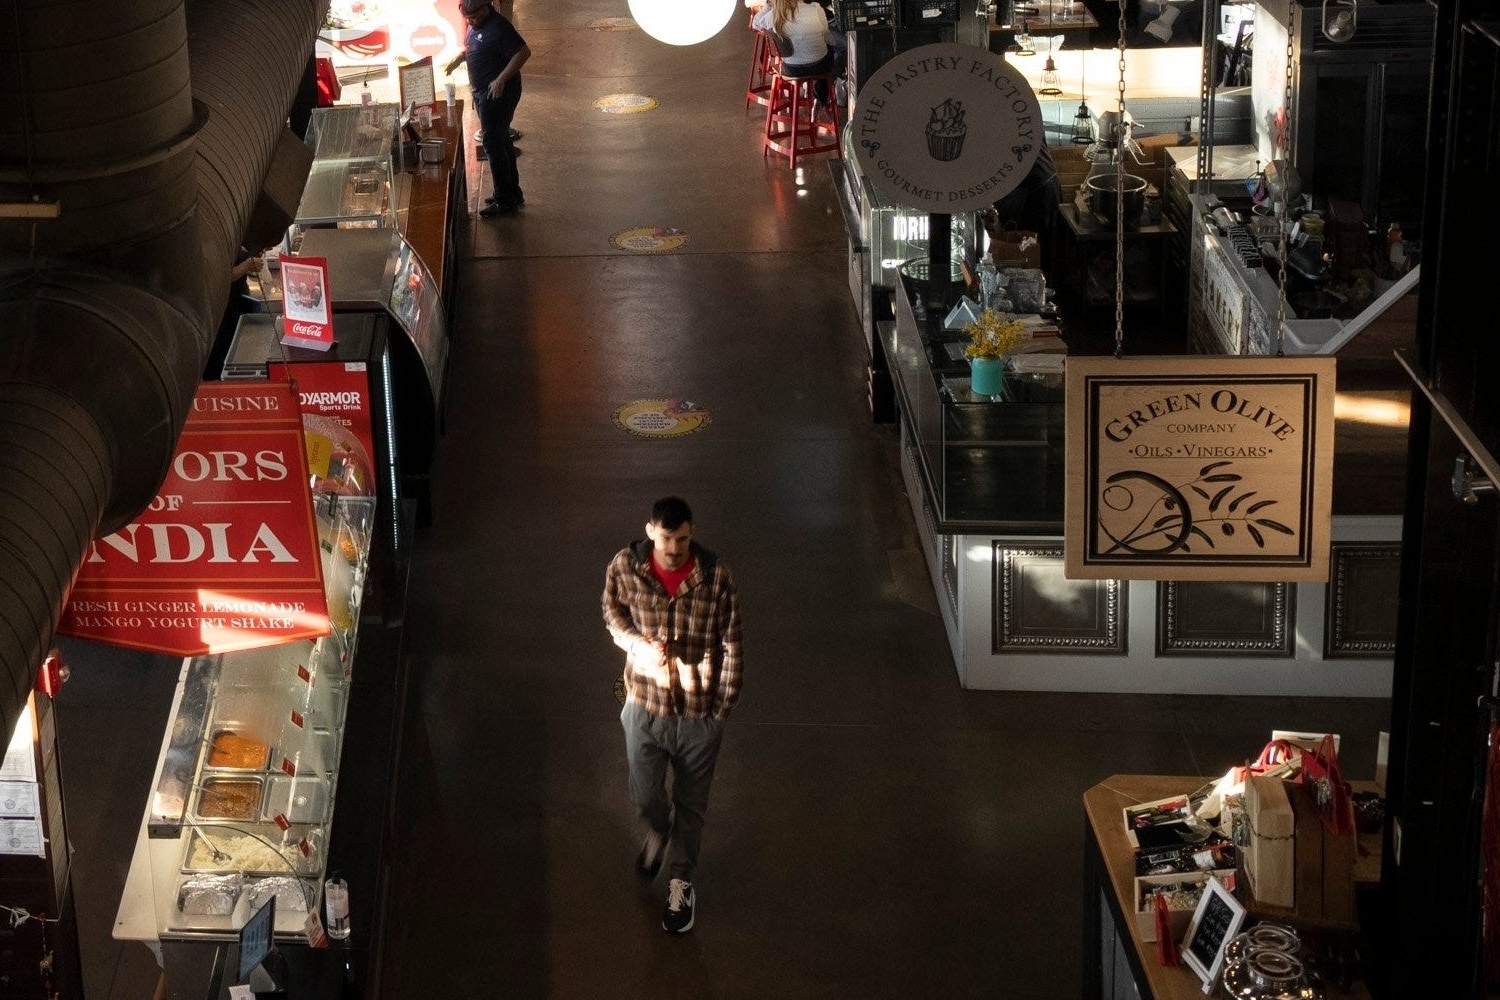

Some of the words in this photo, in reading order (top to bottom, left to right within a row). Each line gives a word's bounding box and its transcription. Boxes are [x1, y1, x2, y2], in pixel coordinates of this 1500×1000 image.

[862, 97, 886, 137] THE
[882, 56, 963, 95] PASTRY
[969, 59, 1033, 142] FACTORY
[877, 159, 944, 202] GOURMET
[949, 162, 1013, 202] DESSERTS
[192, 395, 280, 413] UISINE
[299, 391, 361, 405] DYARMOR
[319, 404, 342, 412] Sports
[1104, 392, 1202, 443] GREEN
[1210, 389, 1296, 442] OLIVE
[1166, 422, 1237, 434] COMPANY
[148, 494, 184, 512] OF
[87, 521, 300, 564] NDIA
[71, 600, 119, 614] RESH
[124, 600, 197, 615] GINGER
[201, 600, 306, 614] LEMONADE
[76, 616, 142, 629] MANGO
[146, 616, 227, 629] YOGURT
[231, 616, 296, 630] SHAKE
